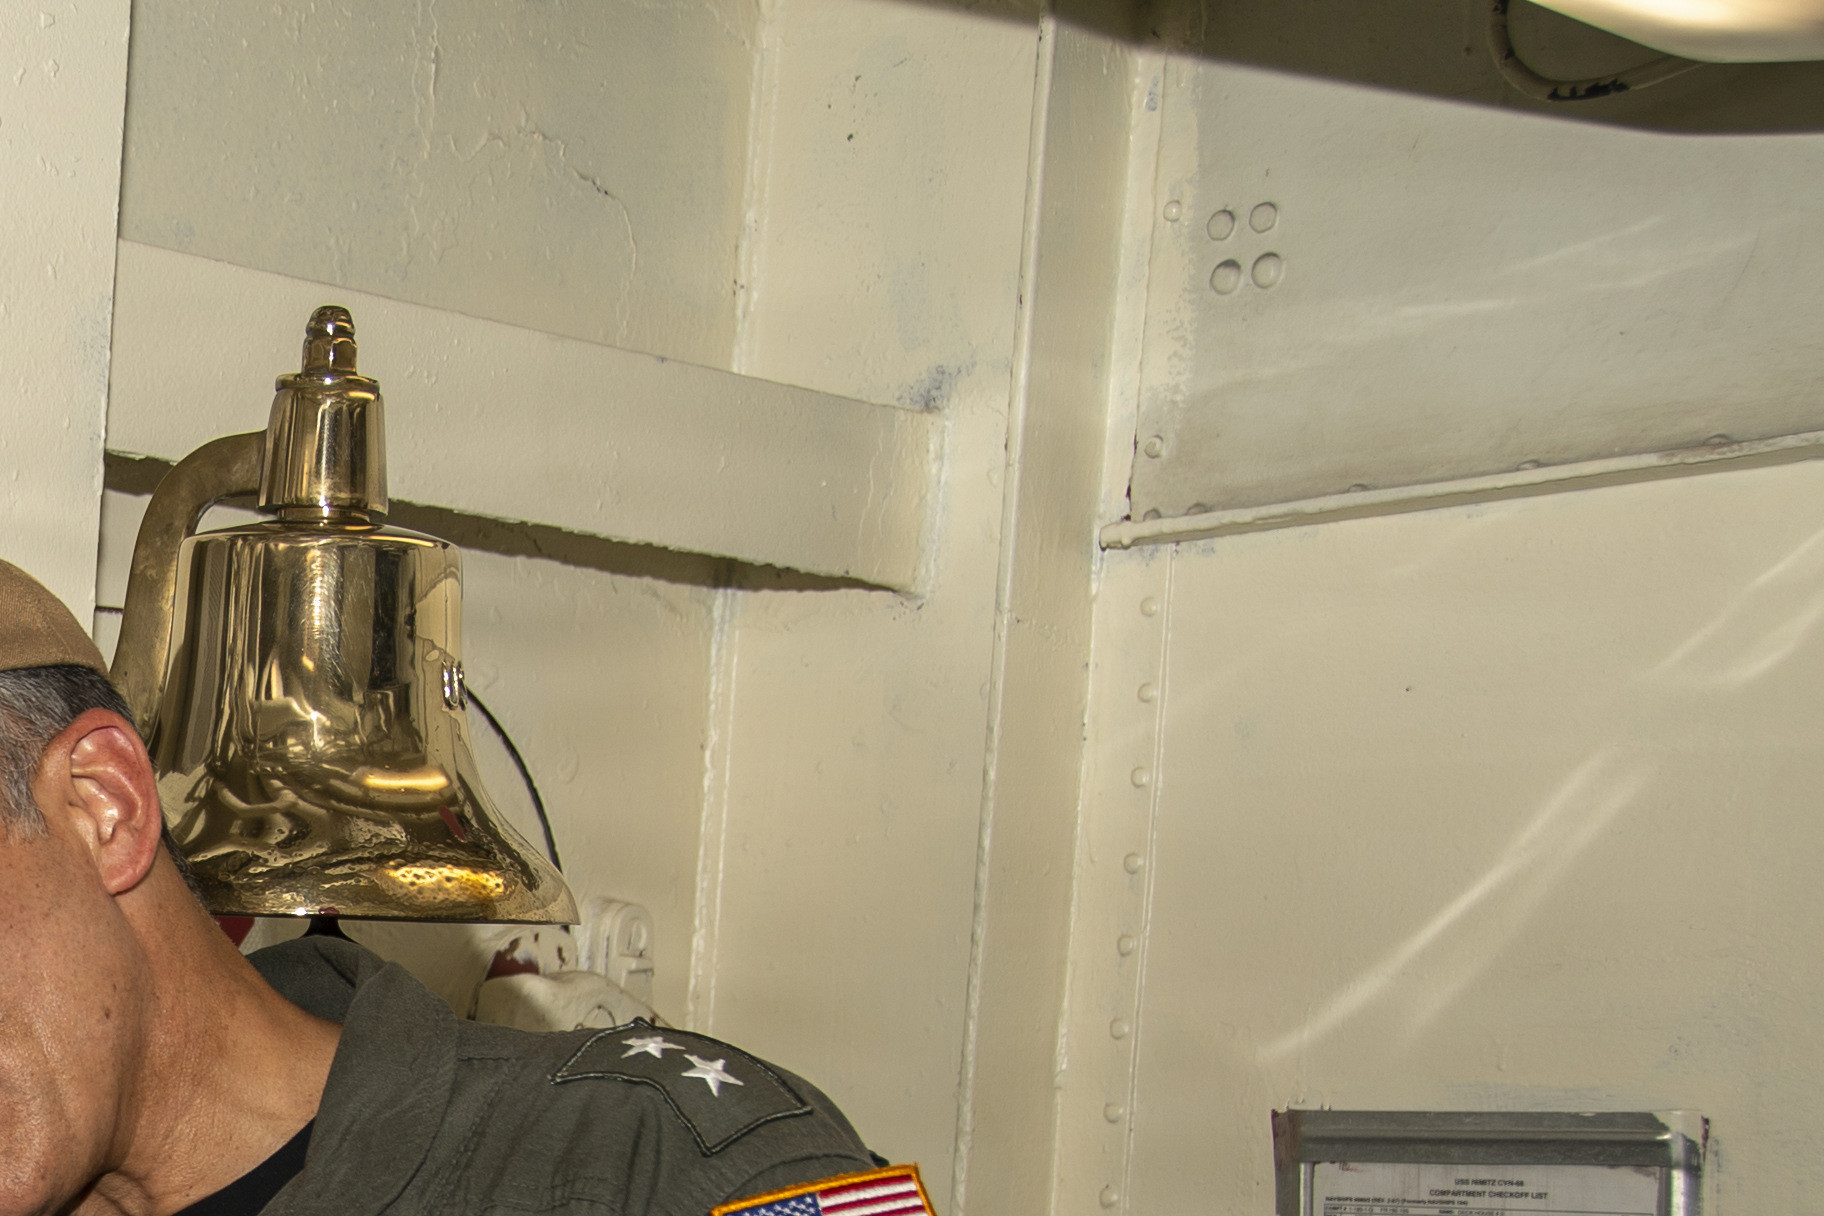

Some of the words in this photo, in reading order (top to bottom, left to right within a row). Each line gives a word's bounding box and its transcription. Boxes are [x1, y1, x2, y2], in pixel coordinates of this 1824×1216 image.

[1455, 1178, 1469, 1187] USS
[1471, 1178, 1496, 1187] NIMITZ
[1429, 1189, 1486, 1199] COMPARTMENT
[1488, 1190, 1529, 1200] CHECKOFF
[1530, 1192, 1548, 1201] LIST
